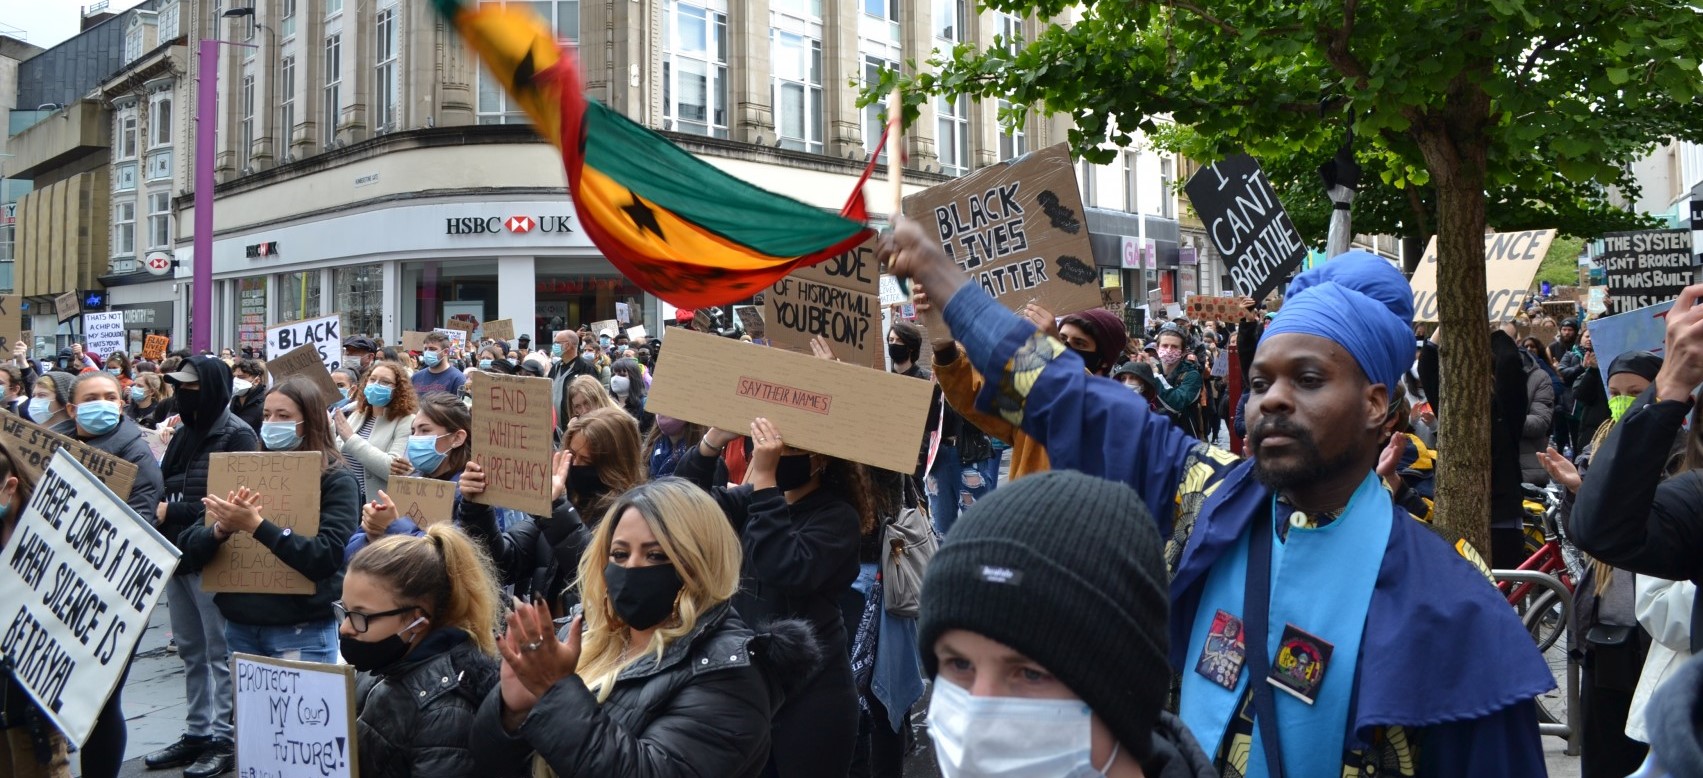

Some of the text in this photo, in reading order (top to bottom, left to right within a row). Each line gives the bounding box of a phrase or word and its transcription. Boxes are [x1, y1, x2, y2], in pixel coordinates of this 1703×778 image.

[446, 215, 573, 235] HSBC UK
[935, 181, 1024, 242] BLACK
[943, 217, 1028, 271] LIVES
[1125, 241, 1155, 267] GAE
[1230, 211, 1300, 298] BREATHE
[1604, 232, 1691, 252] THE SYSTEM
[1606, 252, 1691, 271] ISN'T BROKEN
[1608, 270, 1693, 289] IT WAS BUILT
[773, 277, 872, 318] OF HISTORY WILL
[1611, 295, 1650, 313] THIS
[278, 321, 338, 349] BLACK
[773, 297, 807, 333] YOU
[808, 307, 832, 339] BE
[831, 311, 869, 350] ON?
[490, 386, 527, 414] END
[740, 380, 829, 411] SAY THEIR NAMES
[3, 417, 27, 438] WE
[79, 450, 117, 476] THIS
[488, 421, 528, 450] WHITE
[227, 456, 305, 473] RESPECT
[476, 453, 547, 496] SUPREMACY
[236, 475, 291, 491] BLACK
[396, 481, 446, 498] THE UK IS
[259, 494, 292, 511] PLE
[270, 513, 298, 528] YOU
[32, 467, 164, 613] THERE COMES A TIME
[231, 551, 284, 570] BLACK
[216, 570, 297, 589] CULTURE
[9, 525, 126, 666] WHEN SILENCE IS
[1, 604, 76, 715] BETRAYAL
[238, 662, 300, 694] PROTECT
[269, 695, 291, 728] MY
